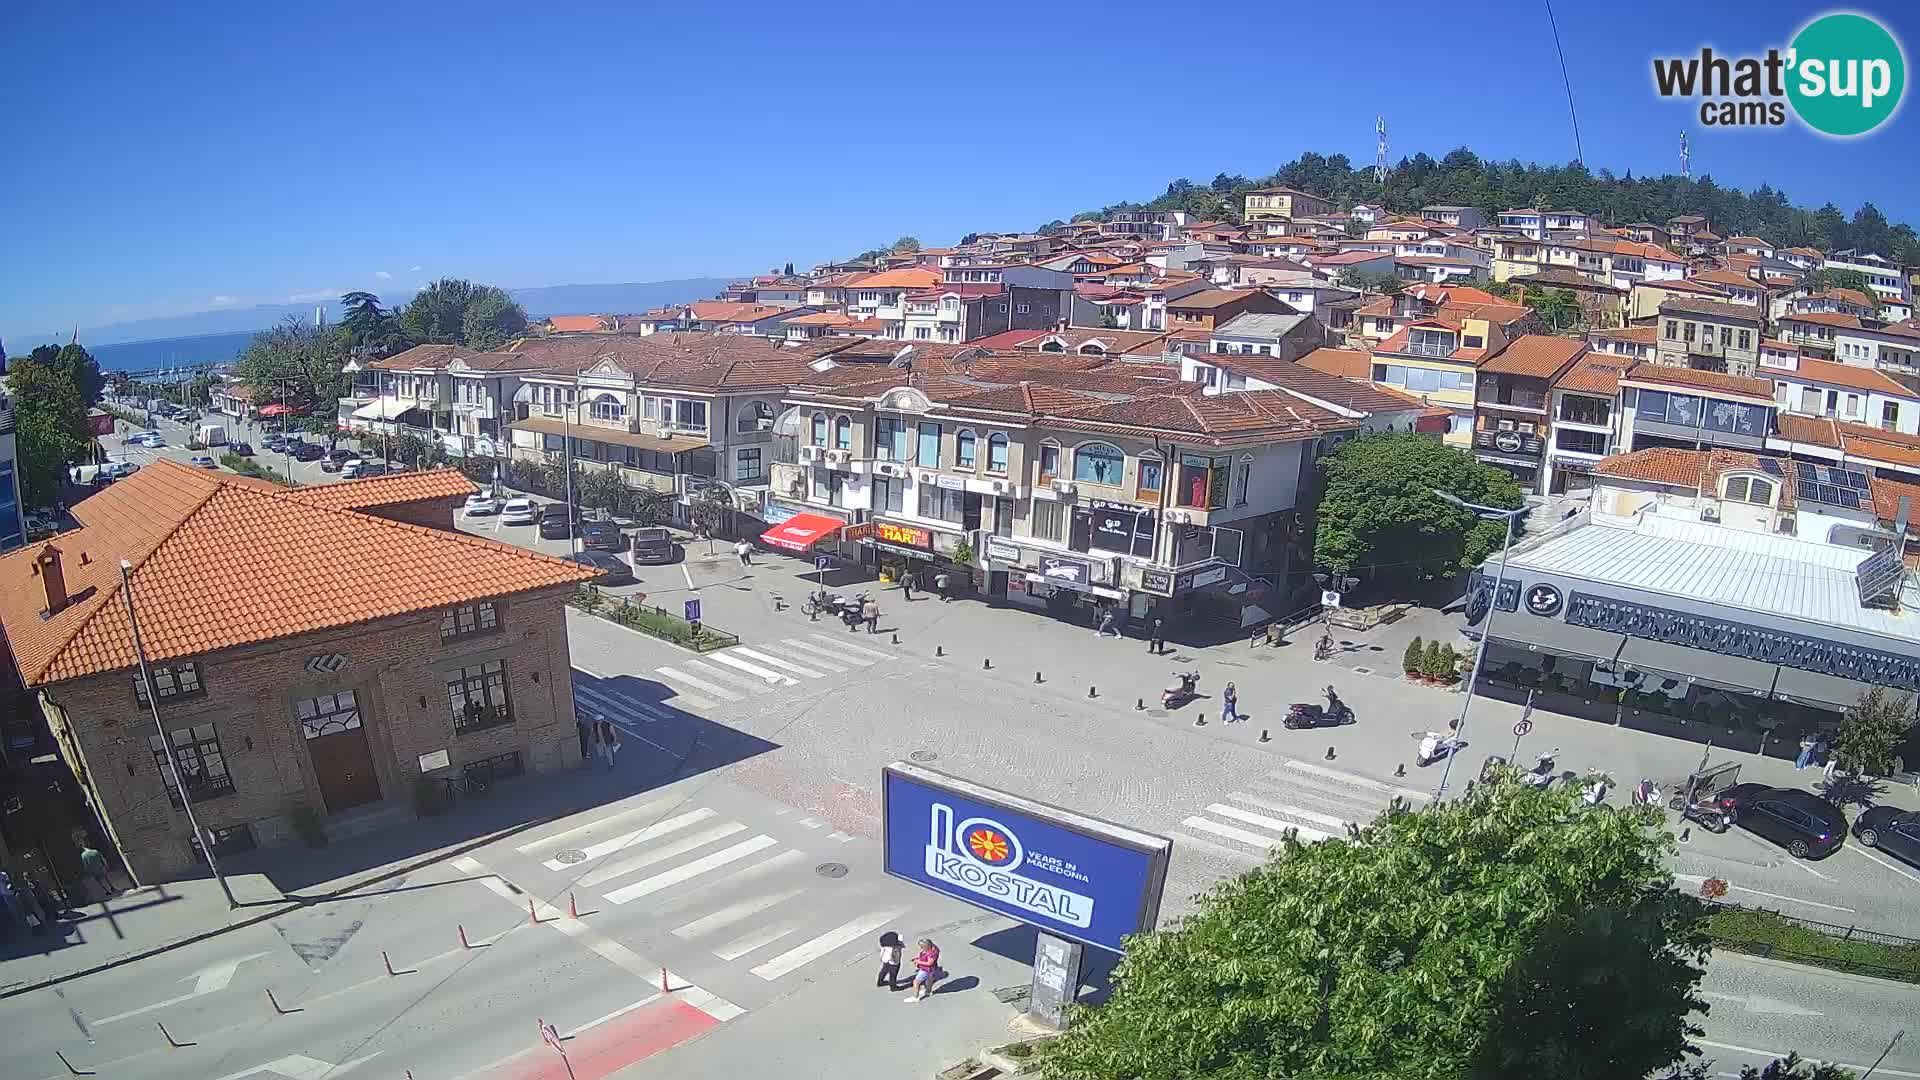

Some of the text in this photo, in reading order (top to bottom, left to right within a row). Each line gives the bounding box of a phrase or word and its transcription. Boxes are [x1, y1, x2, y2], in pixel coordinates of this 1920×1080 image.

[1026, 858, 1089, 883] MACEDONIA
[1027, 850, 1077, 872] YEARS IN
[935, 852, 1080, 921] KOSTAL
